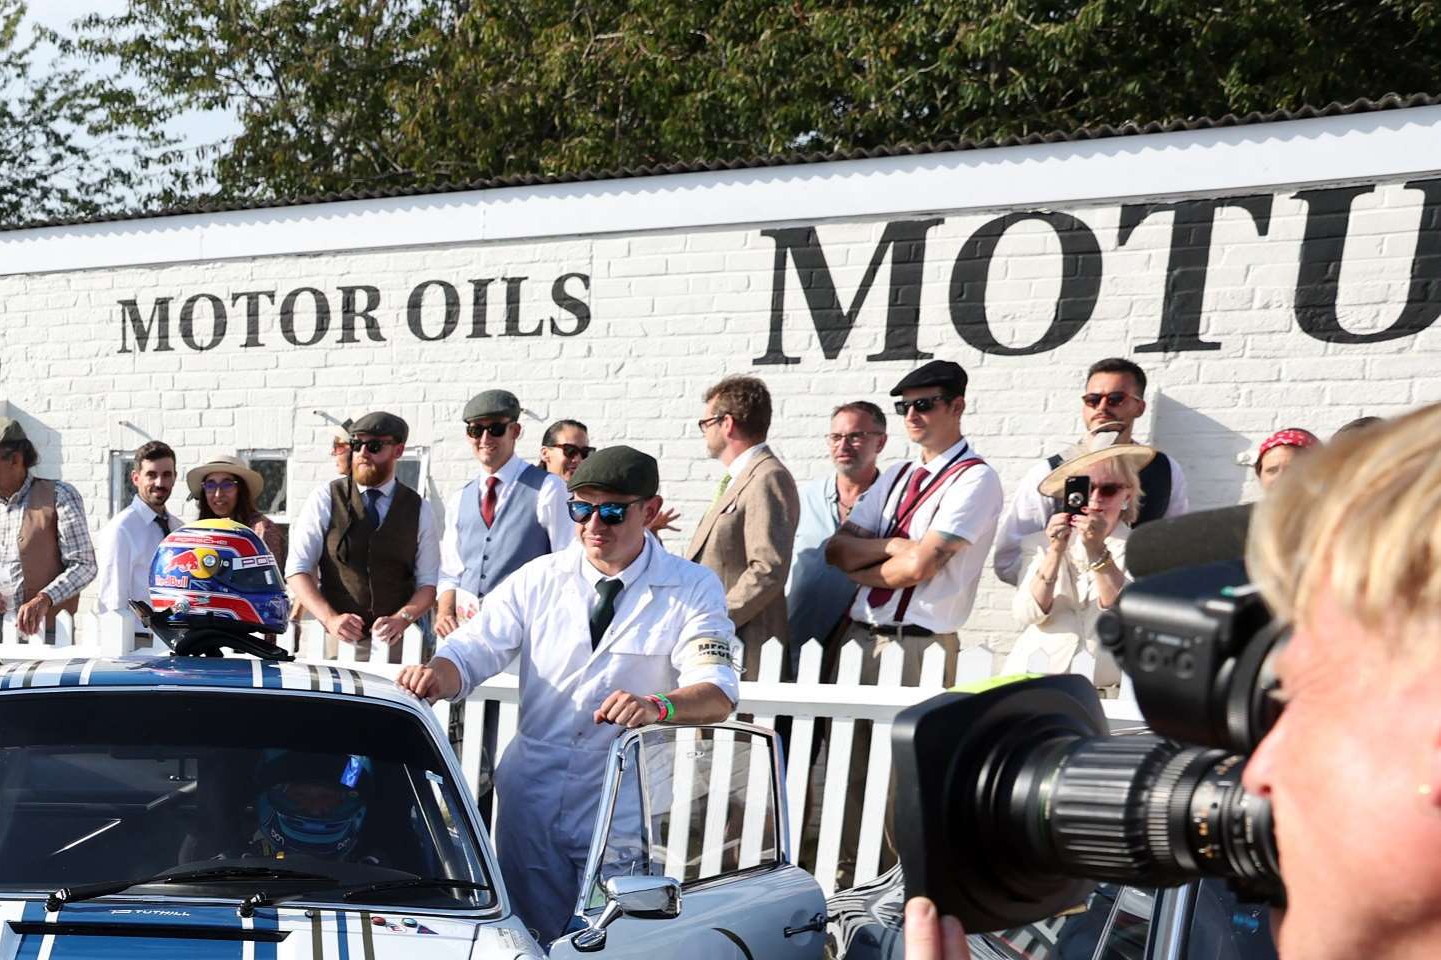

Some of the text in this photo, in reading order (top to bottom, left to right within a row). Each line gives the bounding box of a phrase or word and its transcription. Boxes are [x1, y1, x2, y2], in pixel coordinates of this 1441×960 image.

[117, 272, 591, 354] MOTOR OILS
[752, 177, 1441, 366] MOTU
